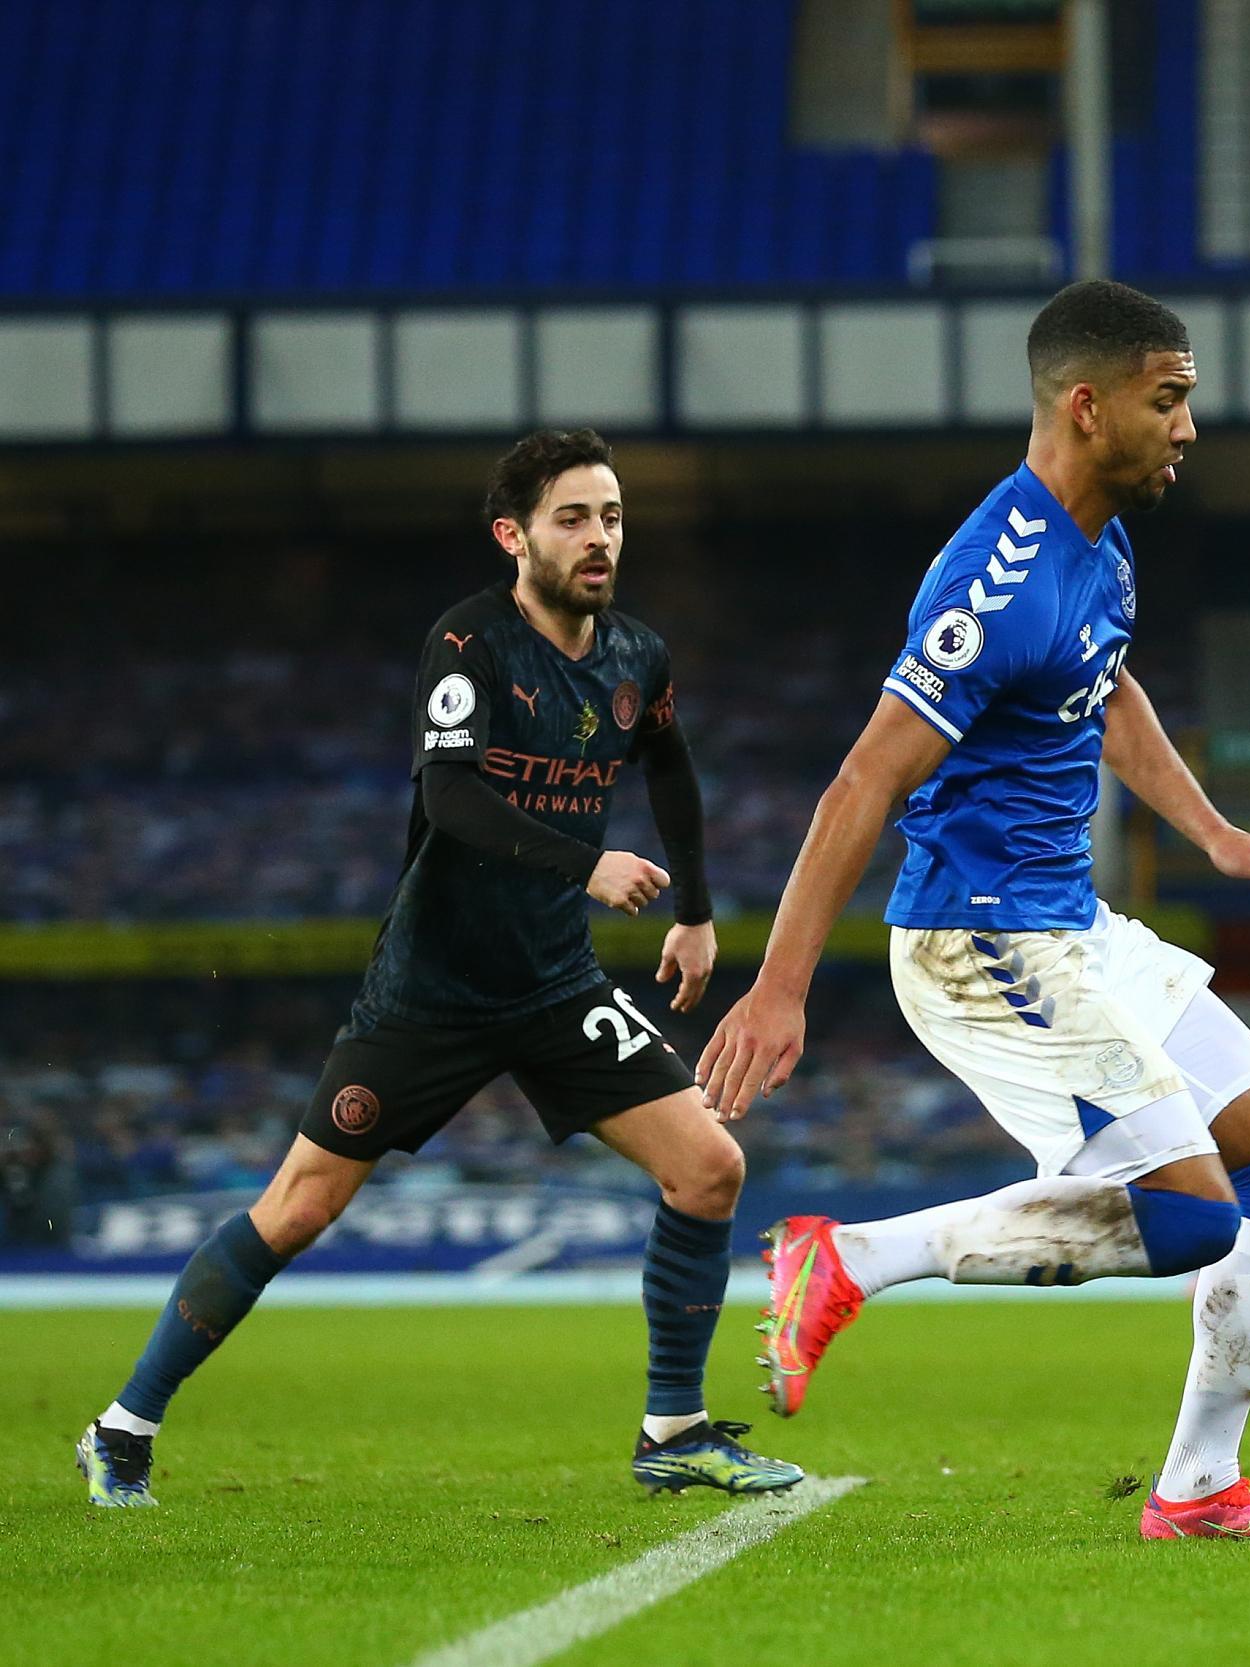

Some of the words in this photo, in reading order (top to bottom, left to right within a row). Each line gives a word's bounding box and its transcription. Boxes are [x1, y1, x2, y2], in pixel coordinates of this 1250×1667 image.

[907, 672, 943, 703] racism
[915, 664, 945, 691] room
[438, 737, 474, 748] racism
[440, 729, 469, 740] room
[506, 789, 603, 814] AIRWAYS
